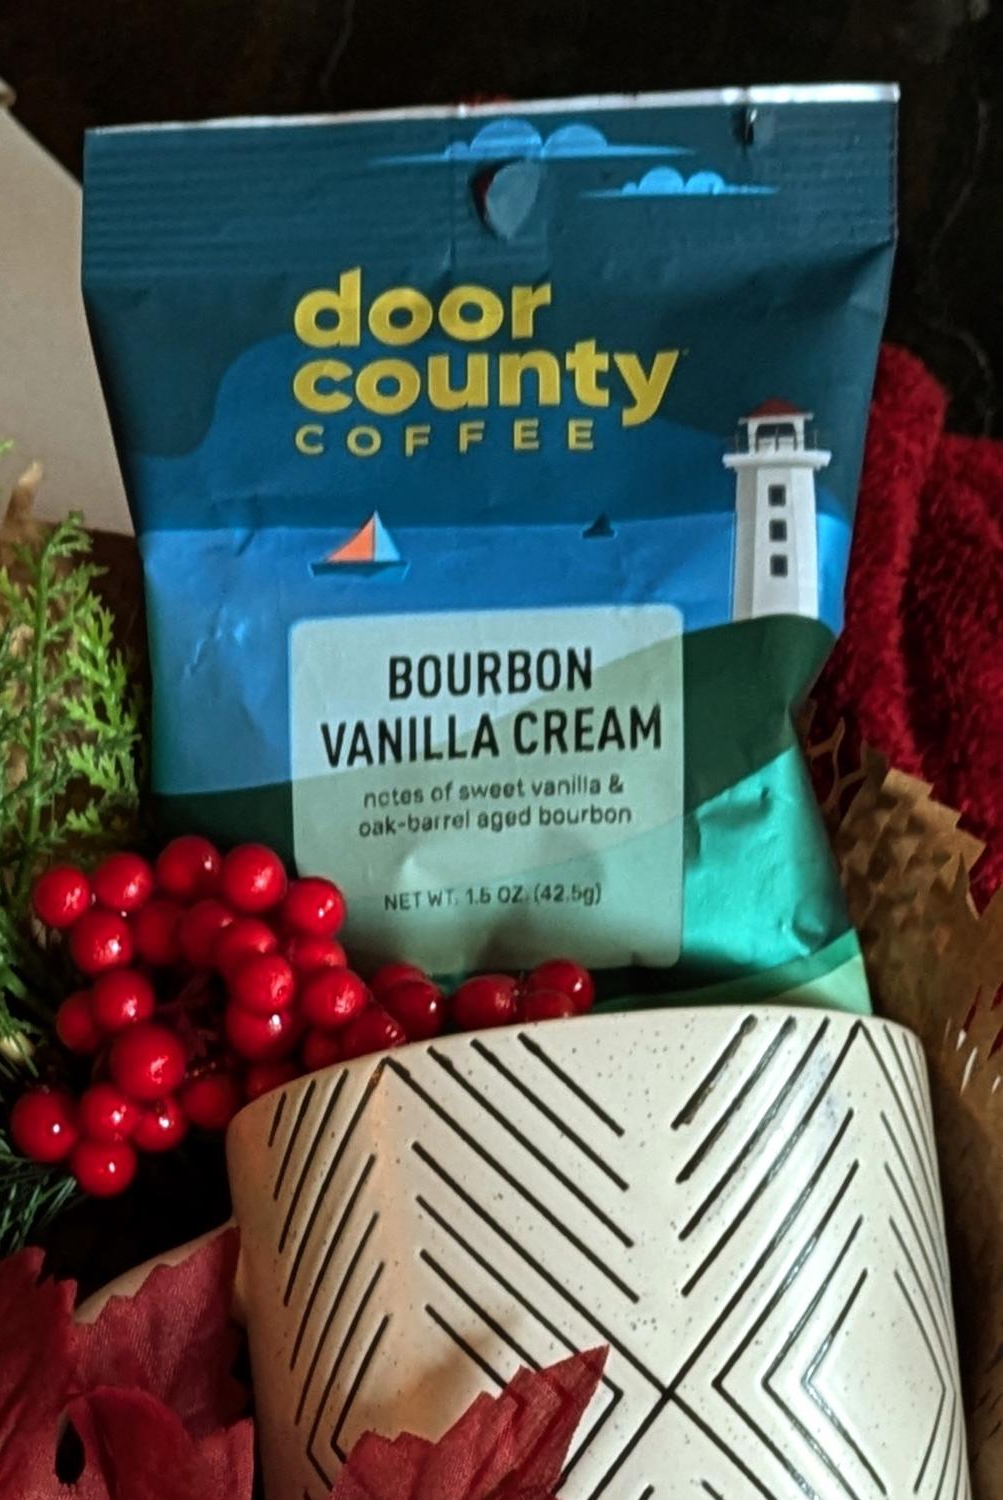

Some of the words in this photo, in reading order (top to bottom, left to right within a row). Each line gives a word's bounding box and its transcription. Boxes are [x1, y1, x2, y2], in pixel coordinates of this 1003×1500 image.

[294, 266, 551, 348] door
[293, 339, 679, 427] county
[295, 418, 594, 458] COFFEE
[389, 647, 593, 700] BOURBON
[321, 713, 500, 768] VANILLA
[513, 703, 662, 755] CREAM
[363, 786, 424, 808] notes
[430, 781, 454, 801] of
[459, 779, 525, 800] sweet
[531, 774, 601, 797] vanilla
[609, 773, 624, 792] &
[359, 813, 470, 838] oak-barrel
[477, 806, 531, 832] aged
[539, 804, 632, 826] bourbon
[384, 890, 421, 911] NET
[428, 888, 458, 908] WT.
[467, 887, 491, 906] 1.5
[534, 882, 602, 906] (42.5g)
